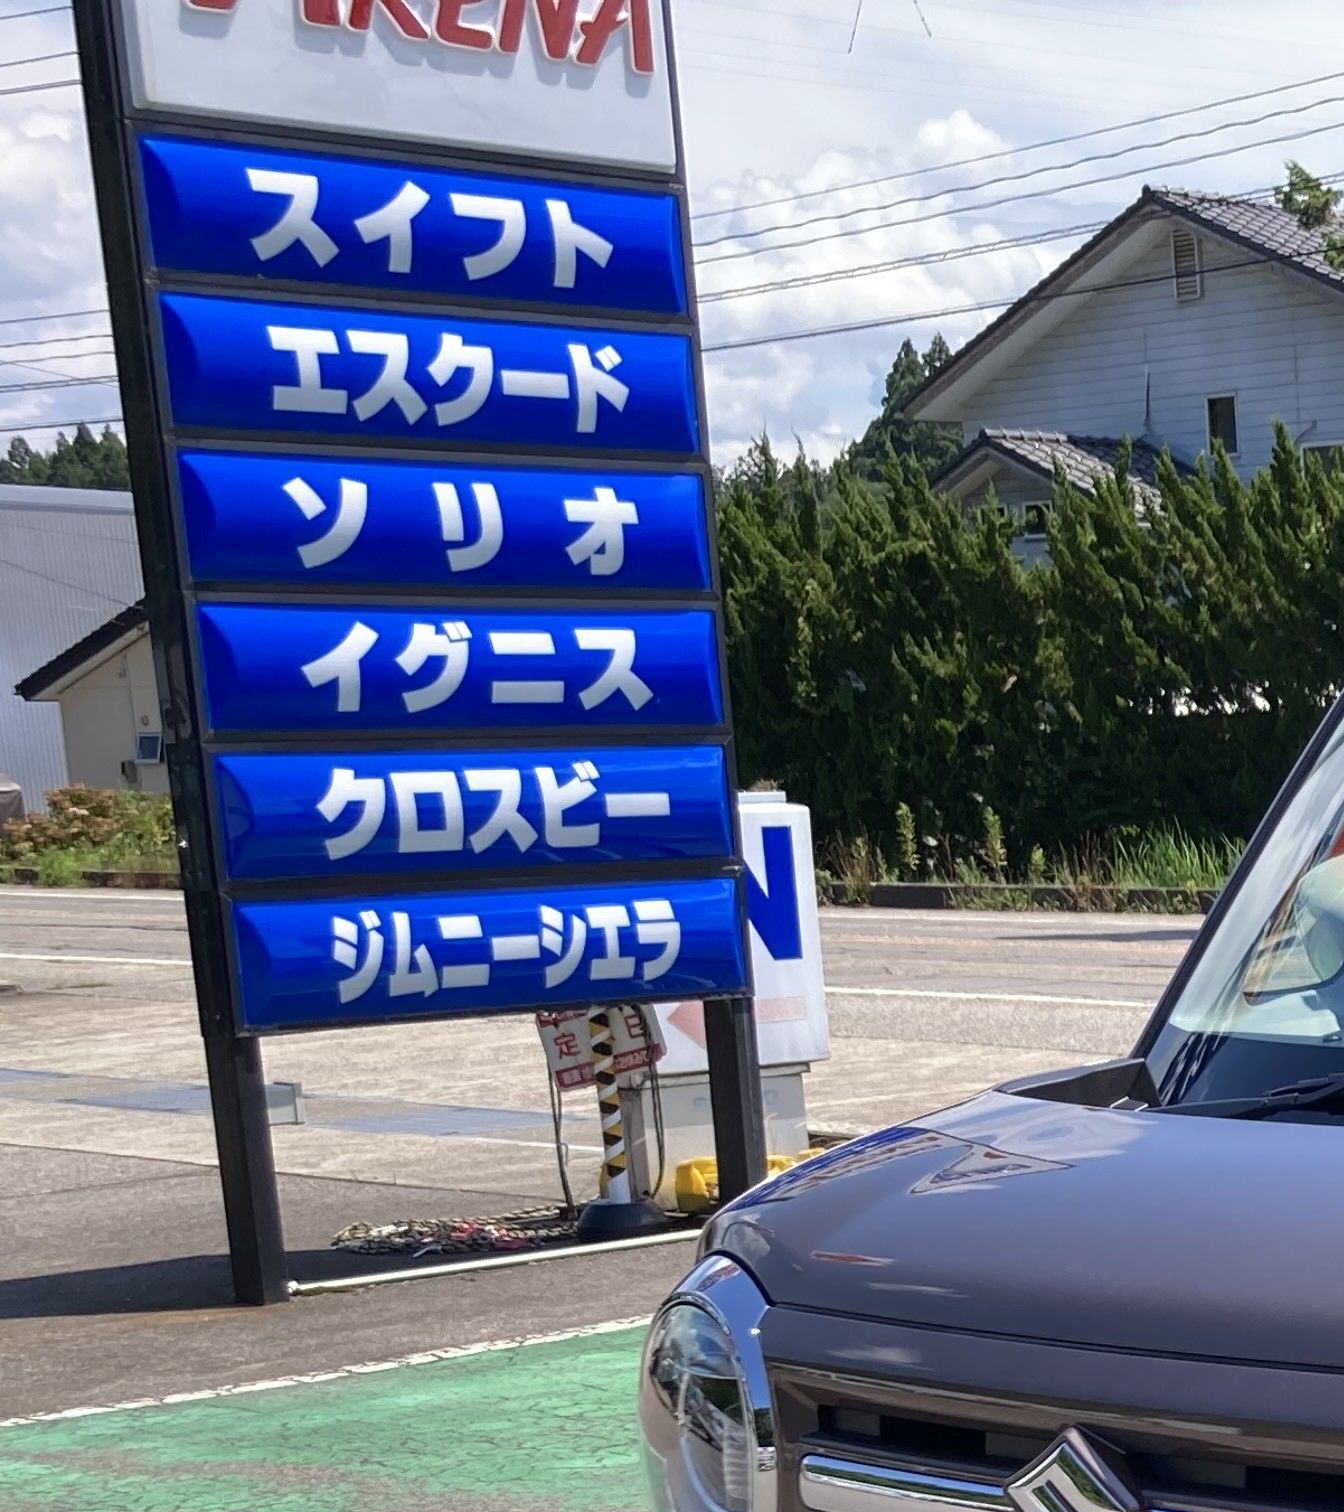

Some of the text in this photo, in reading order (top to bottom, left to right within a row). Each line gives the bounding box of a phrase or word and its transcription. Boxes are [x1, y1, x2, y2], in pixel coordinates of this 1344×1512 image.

[244, 168, 613, 288] スイフト
[267, 325, 629, 433] エスクード
[283, 477, 638, 575] ソリオ
[301, 620, 653, 713] イグニス
[316, 760, 671, 860] クロスビー
[331, 899, 682, 1002] ジムニーシエラ
